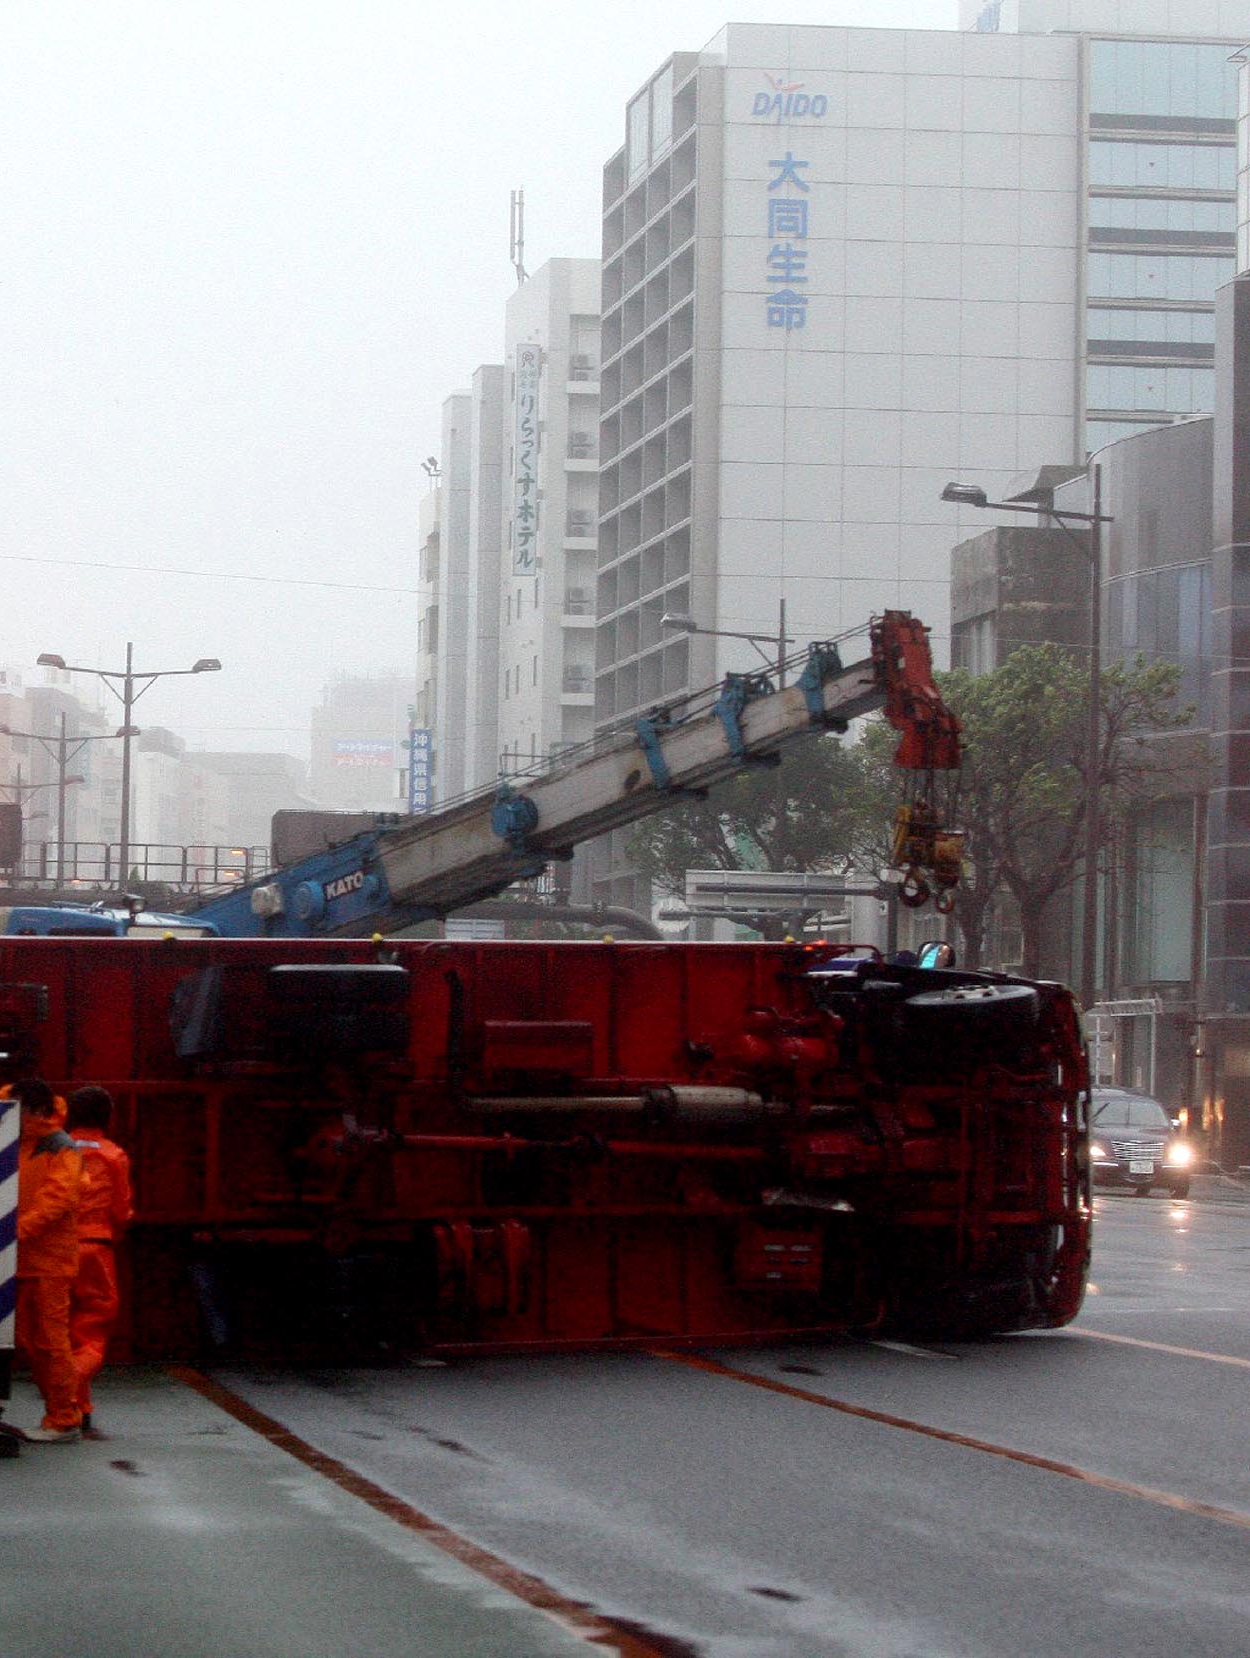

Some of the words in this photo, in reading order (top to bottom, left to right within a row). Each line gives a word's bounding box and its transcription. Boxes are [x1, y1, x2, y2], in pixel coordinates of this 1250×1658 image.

[752, 92, 829, 125] DAIDO
[766, 151, 810, 330] 大同生命
[516, 393, 536, 569] りらっくすホテル
[325, 870, 364, 899] KATO
